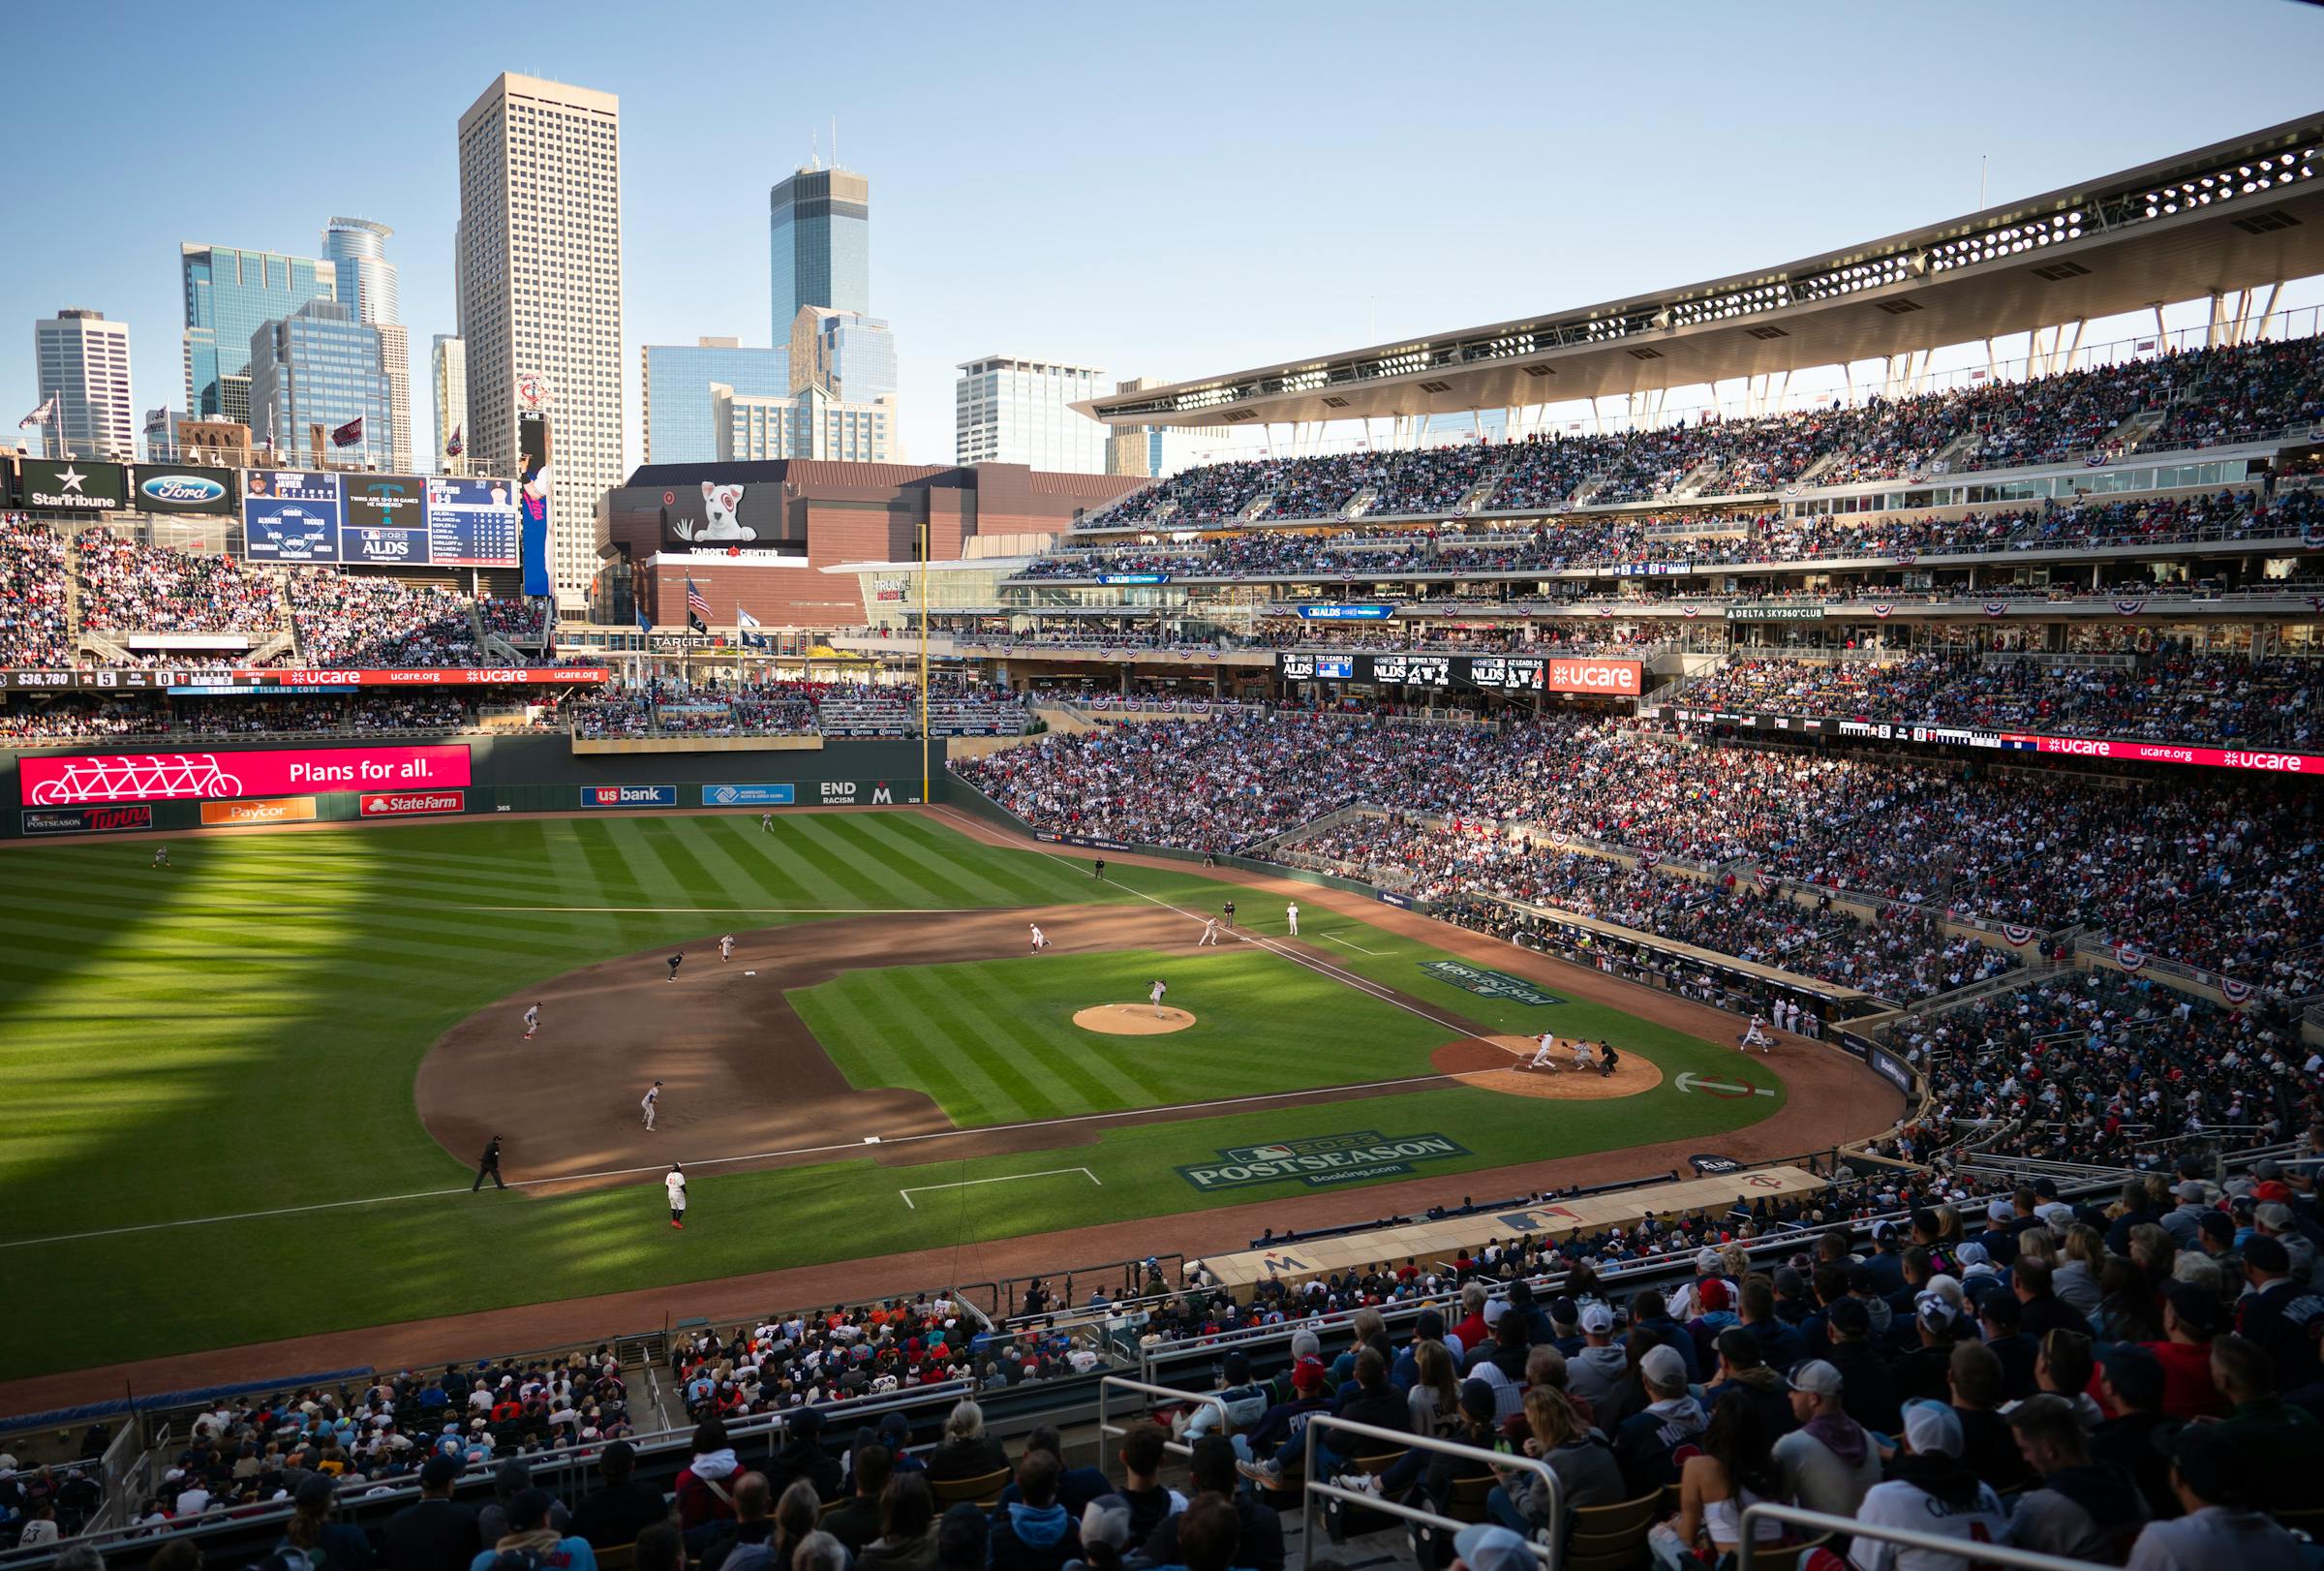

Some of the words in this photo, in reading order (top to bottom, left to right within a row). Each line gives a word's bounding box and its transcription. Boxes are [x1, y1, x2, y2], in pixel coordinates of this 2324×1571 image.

[158, 479, 208, 499] Ford
[275, 480, 302, 488] JAVIER
[32, 492, 116, 508] StarTribune
[436, 494, 450, 503] 0-0
[363, 541, 409, 554] ALDS
[689, 548, 728, 556] TARGET
[740, 549, 778, 557] CENTER
[874, 580, 901, 590] TRULY
[654, 638, 710, 647] TARGET
[1284, 663, 1313, 674] ALDS
[1374, 665, 1407, 677] NLDS
[1472, 668, 1505, 680] NLDS
[18, 673, 68, 686] $36,780
[103, 674, 110, 685] 5
[161, 674, 168, 684] 0
[306, 671, 360, 684] ucare
[391, 672, 440, 682] ucare.org
[480, 670, 527, 682] ucare
[555, 671, 598, 680] ucare.org
[1570, 666, 1632, 687] ucare
[822, 728, 845, 737] Corona
[929, 727, 952, 736] Corona
[963, 727, 985, 735] Corona
[1882, 727, 1886, 736] 5
[1918, 729, 1922, 739] 0
[2061, 740, 2109, 755] ucare
[2140, 747, 2192, 761] ucare.org
[2241, 753, 2301, 770] ucare
[290, 762, 354, 782] Plans
[359, 761, 394, 779] for
[400, 759, 433, 777] all.
[598, 790, 617, 801] us
[620, 787, 659, 800] bank
[820, 782, 856, 795] END
[872, 788, 892, 804] M
[27, 819, 81, 828] POSTSEASON
[83, 807, 151, 829] Twins
[231, 806, 287, 820] Paycor
[1430, 961, 1554, 1004] POSTSEASON
[1292, 1135, 1381, 1154] 2023
[1189, 1138, 1456, 1185] POSTSEASON
[1309, 1163, 1401, 1183] Booking.com
[1264, 1256, 1309, 1272] M
